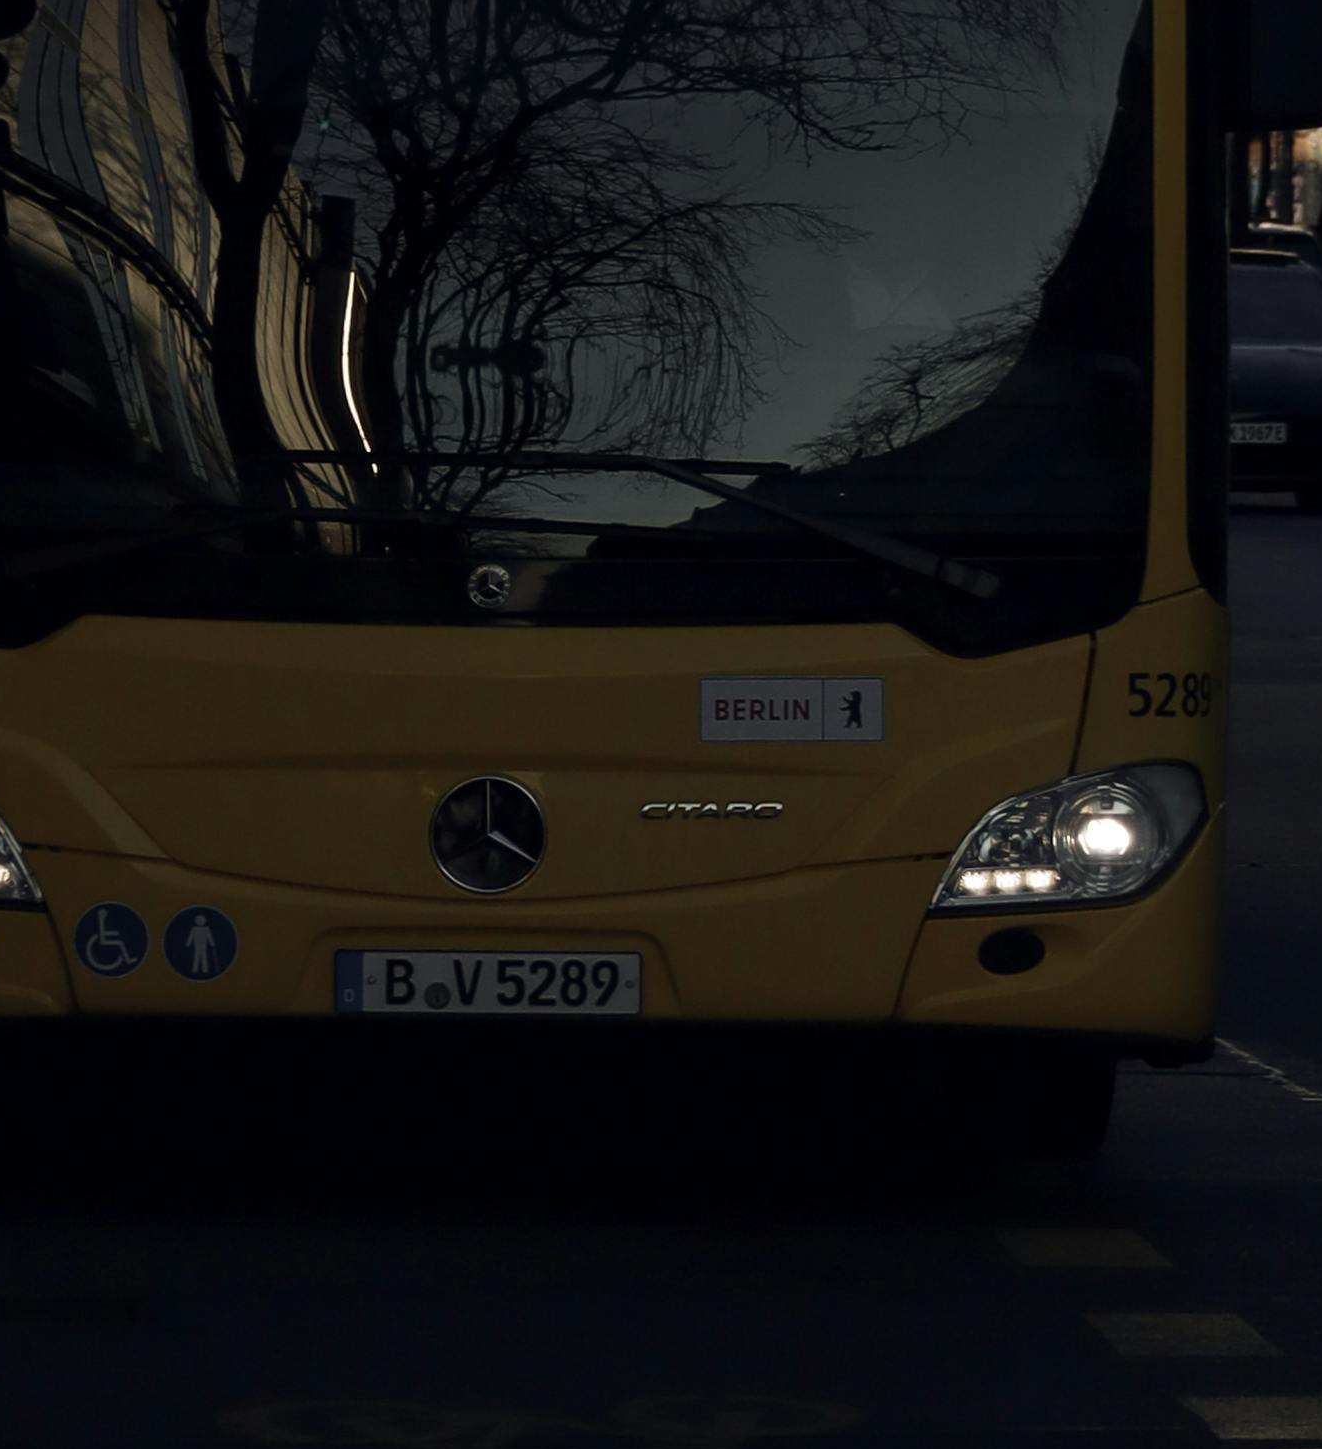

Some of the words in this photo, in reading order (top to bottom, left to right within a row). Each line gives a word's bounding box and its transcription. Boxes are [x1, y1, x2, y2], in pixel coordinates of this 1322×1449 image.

[1127, 672, 1211, 717] 5289
[714, 699, 811, 722] BERLIN
[639, 801, 785, 820] CITARO
